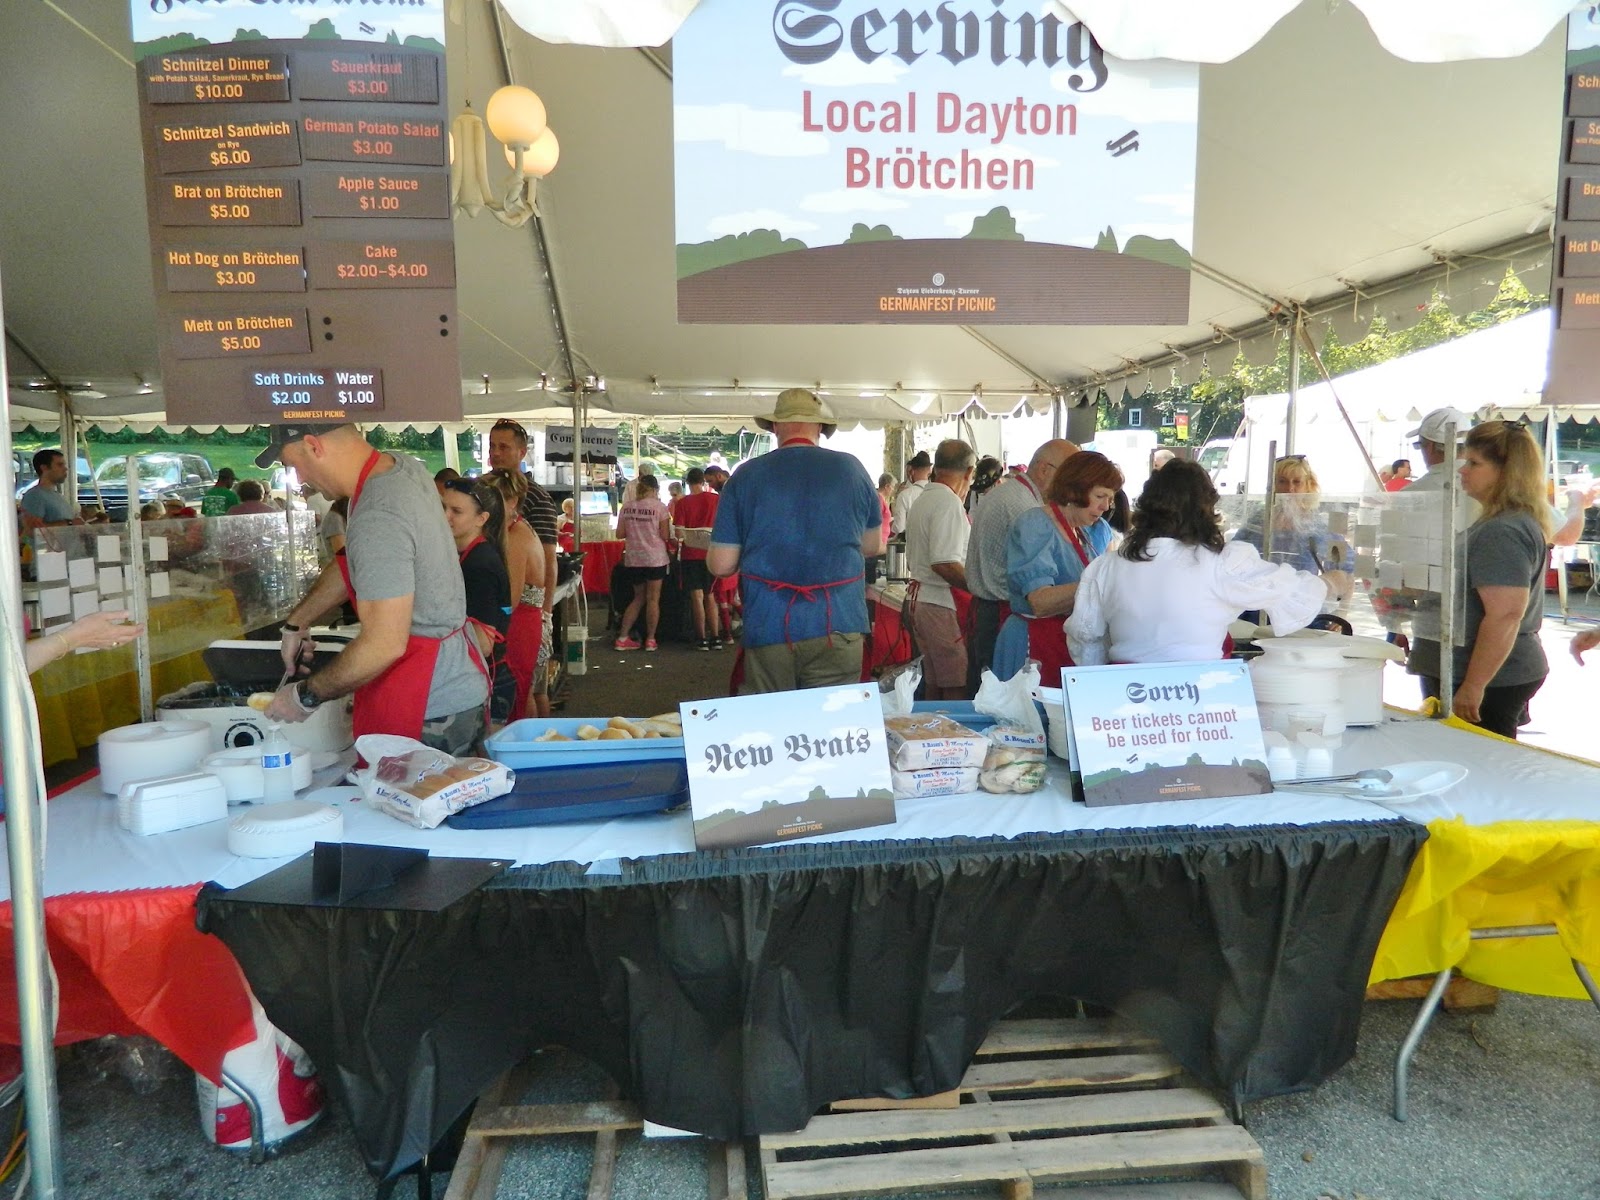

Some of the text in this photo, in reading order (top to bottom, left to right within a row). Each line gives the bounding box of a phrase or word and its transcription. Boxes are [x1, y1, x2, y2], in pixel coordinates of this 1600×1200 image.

[772, 0, 1109, 93] Serving
[162, 57, 270, 72] Schnitzel Dinner
[331, 59, 403, 75] Sauerkraut
[166, 74, 188, 83] Potato
[251, 73, 264, 82] Rye
[265, 72, 285, 81] Bread
[1578, 75, 1600, 88] Sch
[195, 84, 243, 99] $10.00
[348, 79, 387, 95] $3.00
[803, 90, 1078, 145] Local Dayton
[163, 121, 290, 142] Schnitzel Sandwich
[305, 117, 439, 138] German Potato Salad
[227, 140, 240, 149] Rye
[353, 140, 393, 155] $3.00
[210, 150, 251, 166] $6.00
[846, 146, 1035, 190] Brötchen
[174, 184, 283, 199] Brat on Brötchen
[338, 176, 418, 194] Apple Sauce
[360, 195, 399, 211] $1.00
[210, 204, 250, 220] $5.00
[366, 244, 397, 258] Cake
[1568, 240, 1588, 252] Hot
[169, 251, 300, 268] Hot Dog on Brötchen
[216, 270, 256, 285] $3.00
[880, 296, 996, 311] GERMANFEST PICNIC
[184, 316, 293, 333] Mett on Brötchen
[221, 335, 261, 351] $5.00
[255, 371, 325, 386] Soft Drinks
[336, 371, 374, 386] Water
[272, 390, 311, 406] $2.00
[338, 389, 375, 405] $1.00
[283, 410, 346, 418] GERMANFEST PICNIC
[550, 432, 613, 446] Conments
[1126, 681, 1201, 706] Sorry
[1091, 708, 1238, 732] Beer tickets cannot
[1107, 725, 1233, 748] be used for food.
[705, 743, 774, 774] New
[784, 727, 871, 762] Brats
